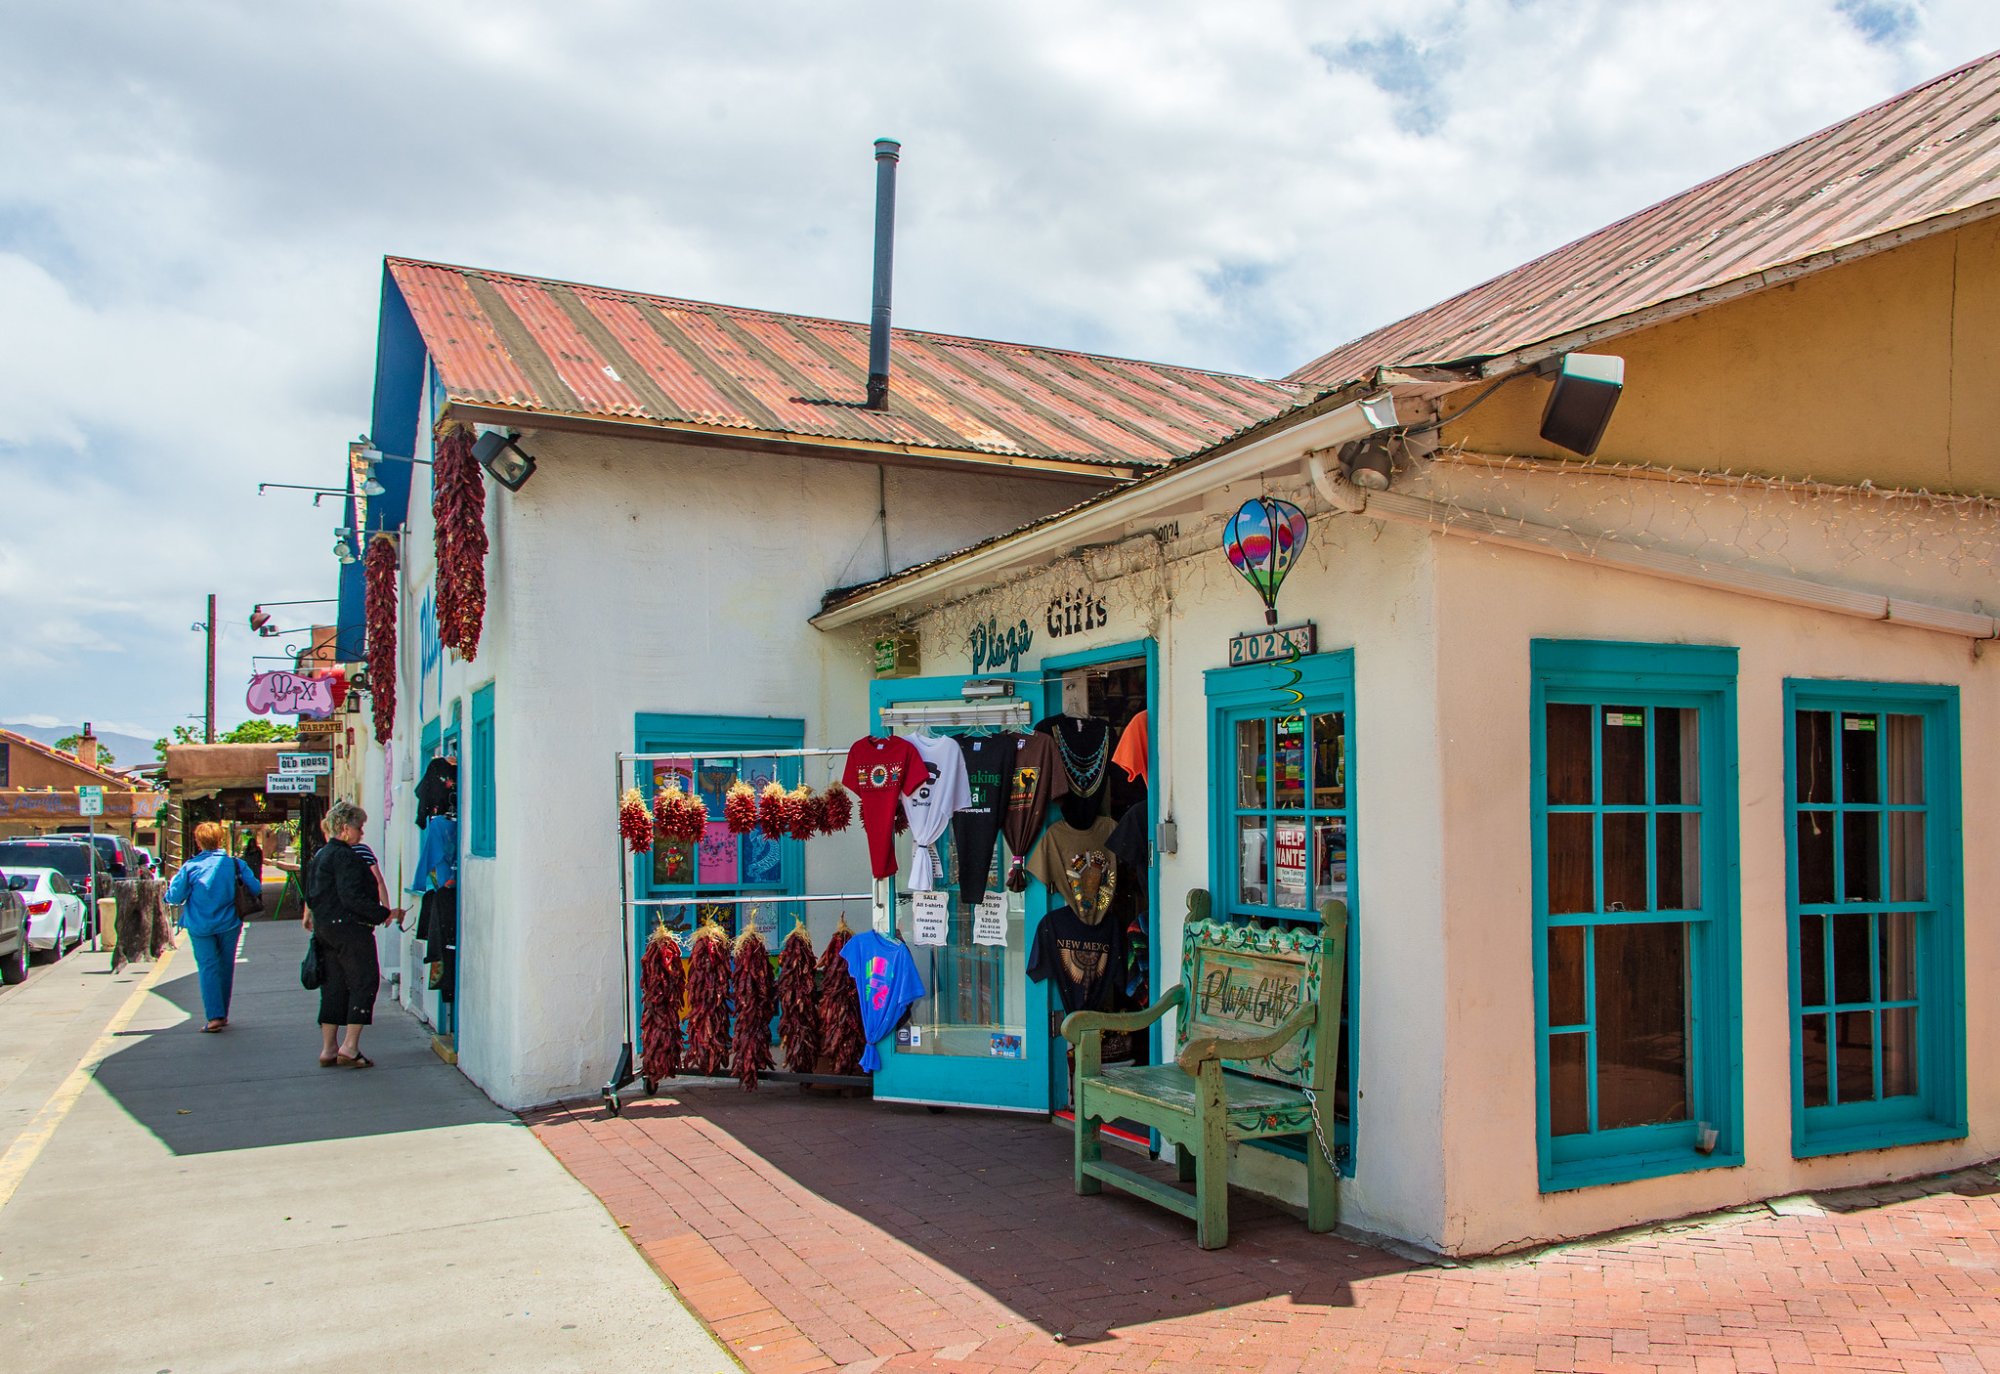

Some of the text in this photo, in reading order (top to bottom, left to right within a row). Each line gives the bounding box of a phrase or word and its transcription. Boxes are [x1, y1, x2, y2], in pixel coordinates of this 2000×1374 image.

[970, 588, 1108, 676] Plaza Gifts
[1233, 631, 1293, 662] 2024
[299, 722, 342, 732] WARPATH
[281, 757, 327, 768] OLD HOUSE
[971, 769, 1000, 786] aking
[1279, 831, 1305, 846] HELP
[1276, 848, 1306, 867] WANTE
[1056, 939, 1080, 949] NEW
[1201, 967, 1253, 1020] Plaza
